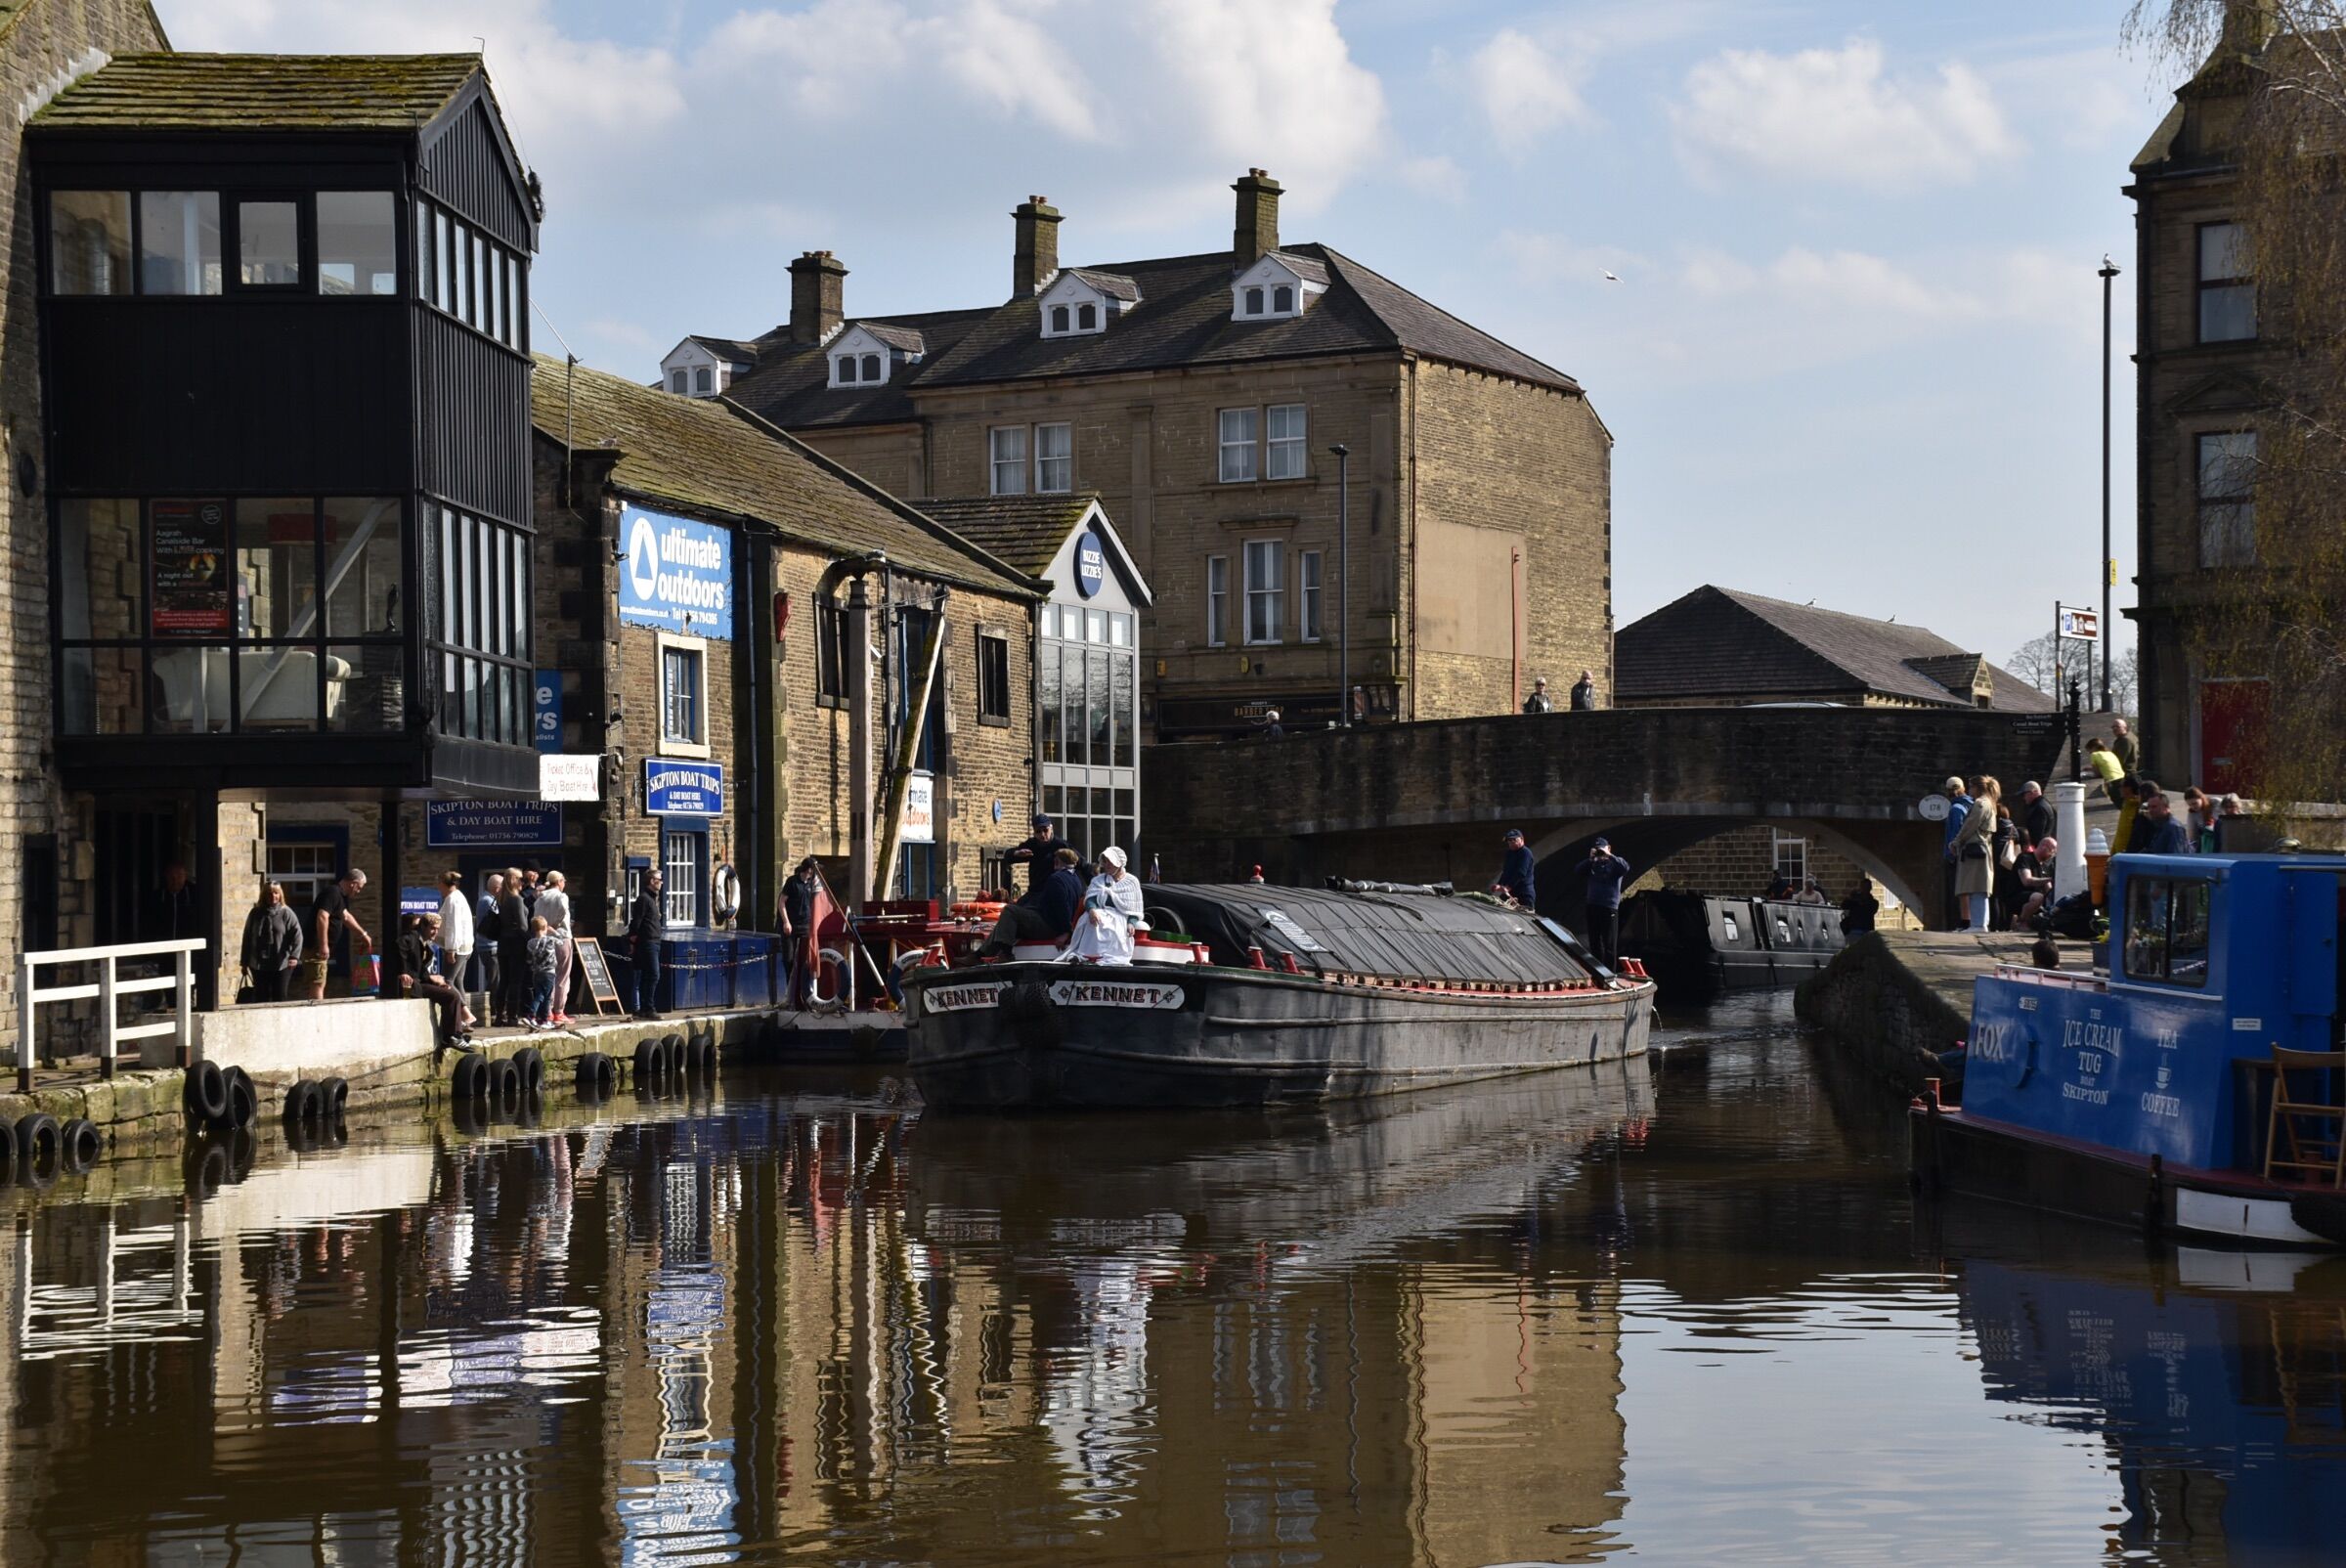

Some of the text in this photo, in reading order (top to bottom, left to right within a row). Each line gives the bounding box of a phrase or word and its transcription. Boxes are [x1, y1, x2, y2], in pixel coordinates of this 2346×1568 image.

[661, 527, 721, 570] ultimate
[1083, 548, 1100, 564] BIZZIE
[1081, 564, 1102, 579] LIZZIE'S
[657, 569, 724, 610] outdoors
[673, 607, 681, 621] Tel
[1235, 706, 1264, 718] BARBER
[565, 762, 584, 775] Office
[559, 780, 576, 792] Boat
[649, 770, 720, 795] SKIPTON BOAT TRIPS
[430, 801, 559, 815] SKIPTON BOAT TRIPS
[447, 815, 543, 826] & DAY BOAT HIRE
[489, 832, 511, 841] 01756
[401, 901, 413, 910] PTON
[936, 987, 999, 1008] KENNET
[1075, 985, 1161, 1004] KENNET
[2090, 1008, 2102, 1020] THE
[1975, 1023, 2007, 1061] FOX
[2063, 1019, 2122, 1058] ICE CREAM
[2157, 1027, 2178, 1049] TEA
[2078, 1051, 2102, 1074] TUG
[2063, 1081, 2108, 1106] SKIPTON
[2142, 1091, 2181, 1117] COFFEE
